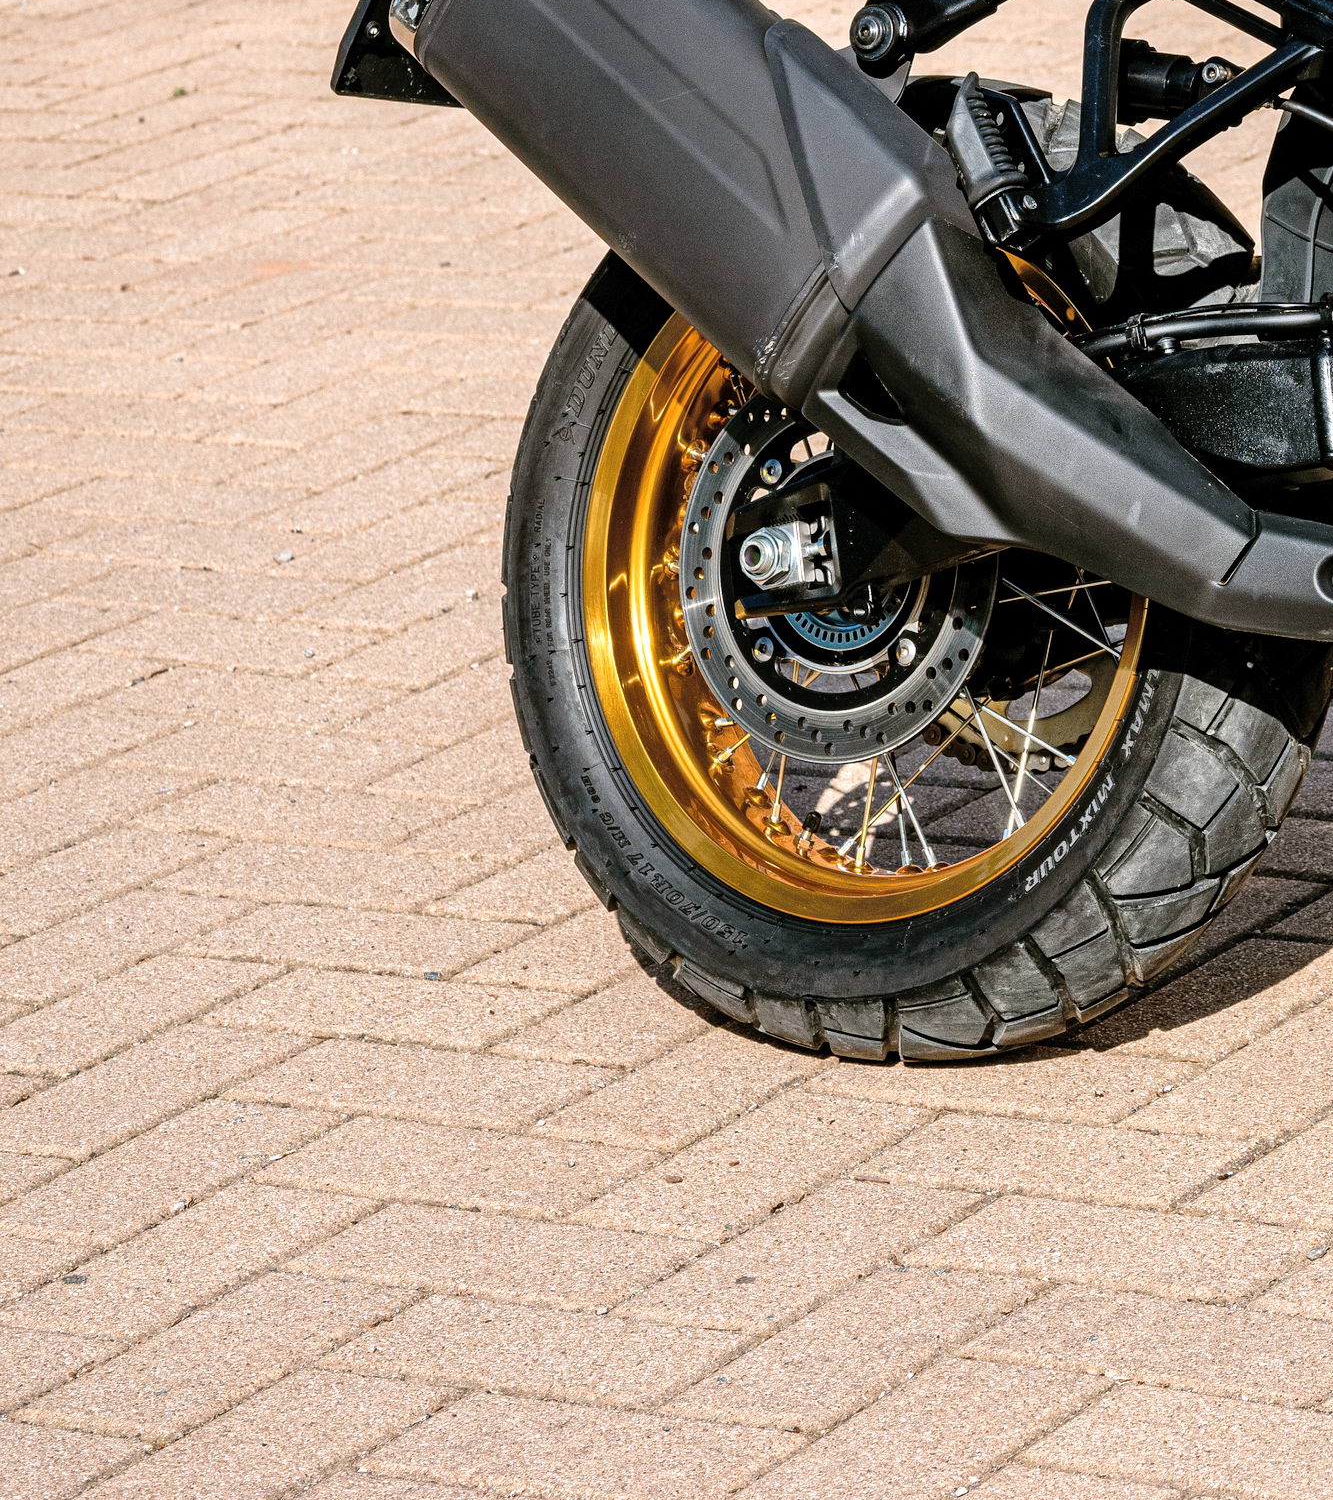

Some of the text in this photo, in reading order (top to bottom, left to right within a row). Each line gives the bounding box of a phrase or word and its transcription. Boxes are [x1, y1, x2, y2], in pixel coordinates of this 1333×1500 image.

[533, 498, 546, 534] RADIAL
[530, 564, 542, 636] TUBE TYPE
[1024, 768, 1116, 895] MIXTOUR
